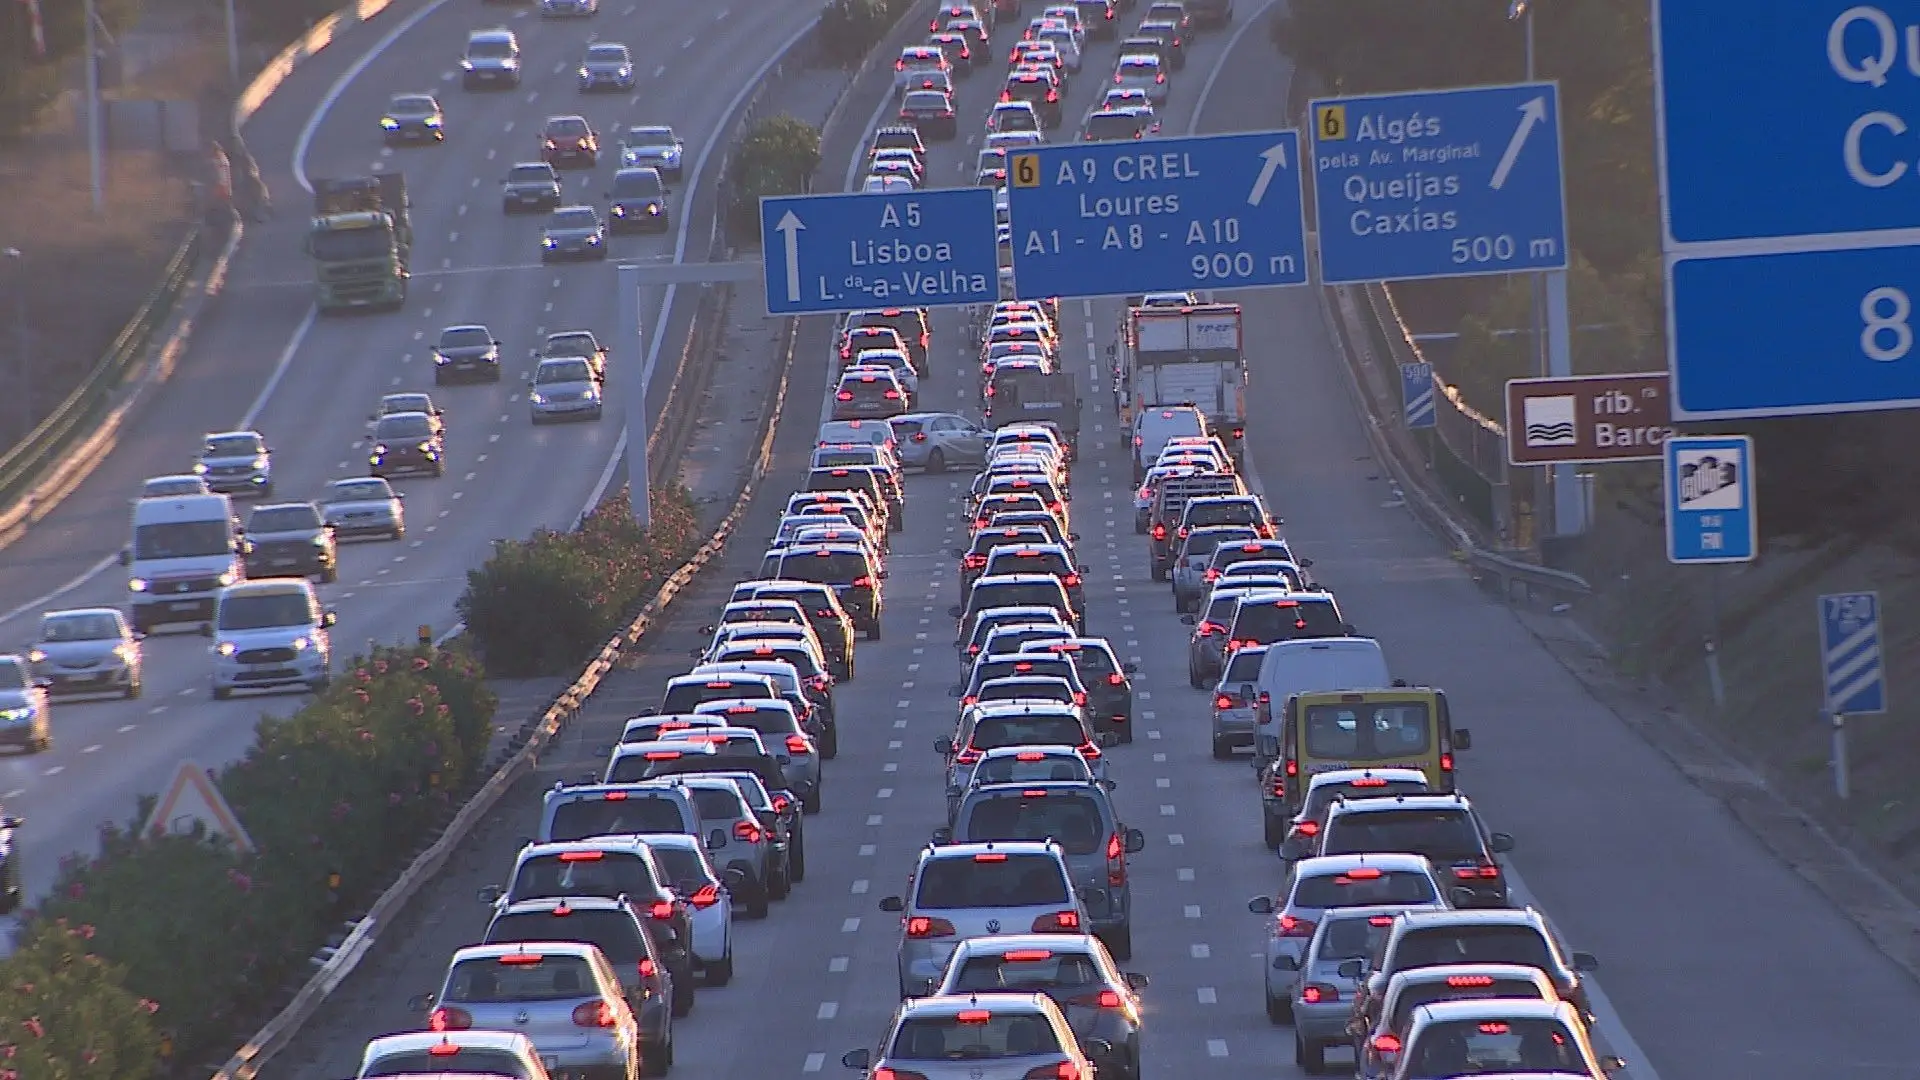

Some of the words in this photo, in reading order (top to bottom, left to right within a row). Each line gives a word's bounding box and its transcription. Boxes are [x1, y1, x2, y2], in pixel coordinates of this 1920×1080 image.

[1324, 109, 1340, 136] 6
[1356, 112, 1440, 144] Algés
[1017, 157, 1035, 183] 6
[1114, 153, 1199, 181] CREL
[1319, 153, 1360, 171] pela
[1370, 150, 1393, 165] Av.
[1403, 141, 1480, 163] Marginal
[1344, 173, 1460, 203] Queijas
[1080, 193, 1179, 217] Loures
[1025, 229, 1059, 255] A1
[1102, 224, 1142, 250] A8
[1186, 218, 1239, 245] A10
[1351, 208, 1457, 236] Caxias
[851, 239, 951, 265] Lisboa
[1452, 236, 1515, 263] 500
[1530, 238, 1556, 257] m
[1192, 252, 1253, 279] 900
[1270, 255, 1294, 274] m
[1861, 287, 1912, 361] 8
